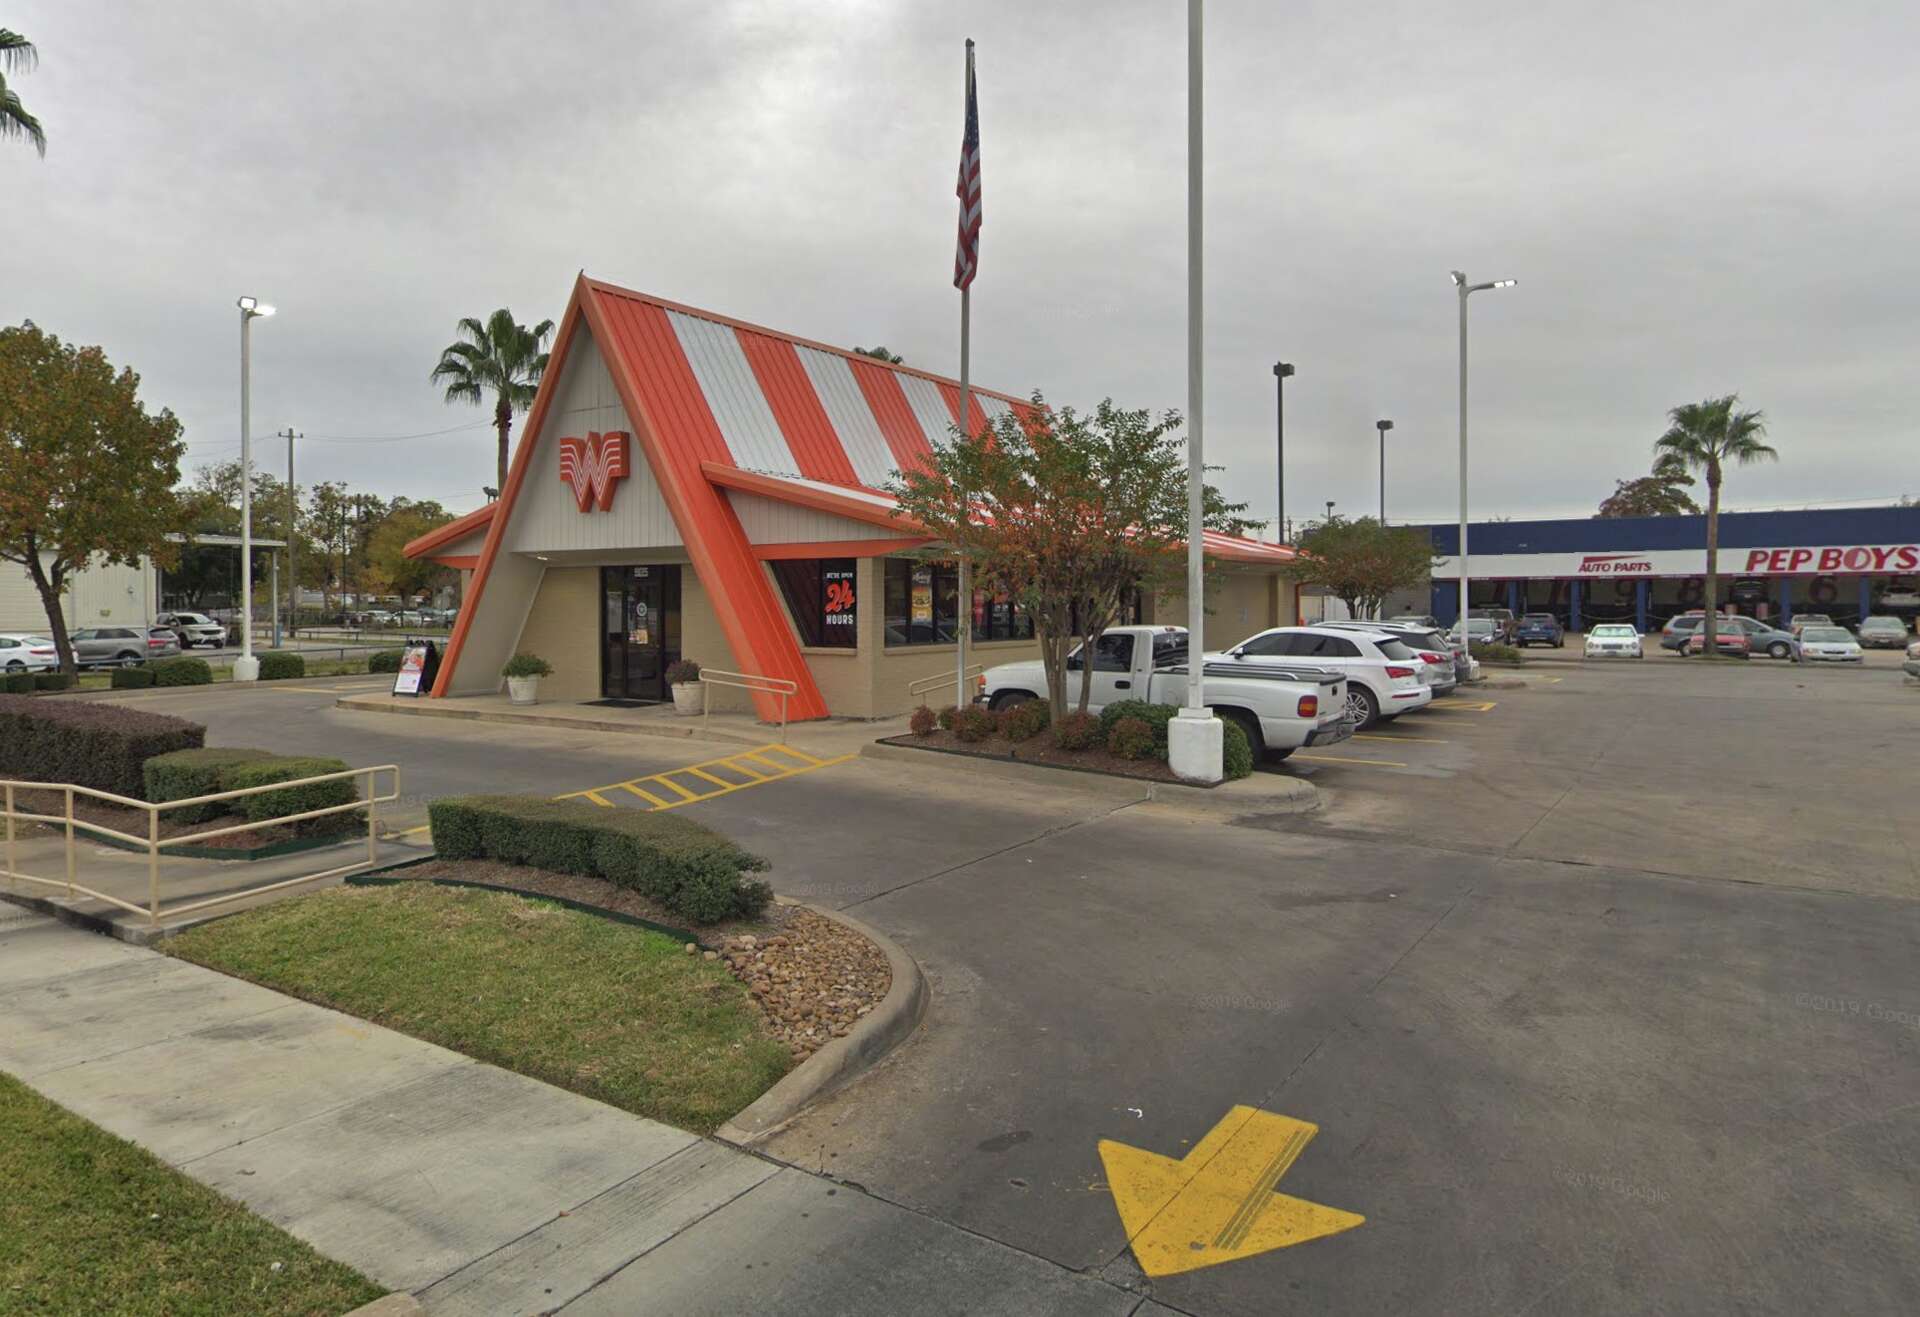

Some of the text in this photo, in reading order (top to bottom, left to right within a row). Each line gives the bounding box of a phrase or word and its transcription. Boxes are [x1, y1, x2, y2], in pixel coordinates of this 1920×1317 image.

[1578, 561, 1652, 573] AUTO PARTS
[1745, 546, 1919, 572] PEP BOYS
[823, 579, 856, 614] 24
[826, 614, 854, 625] HOURS
